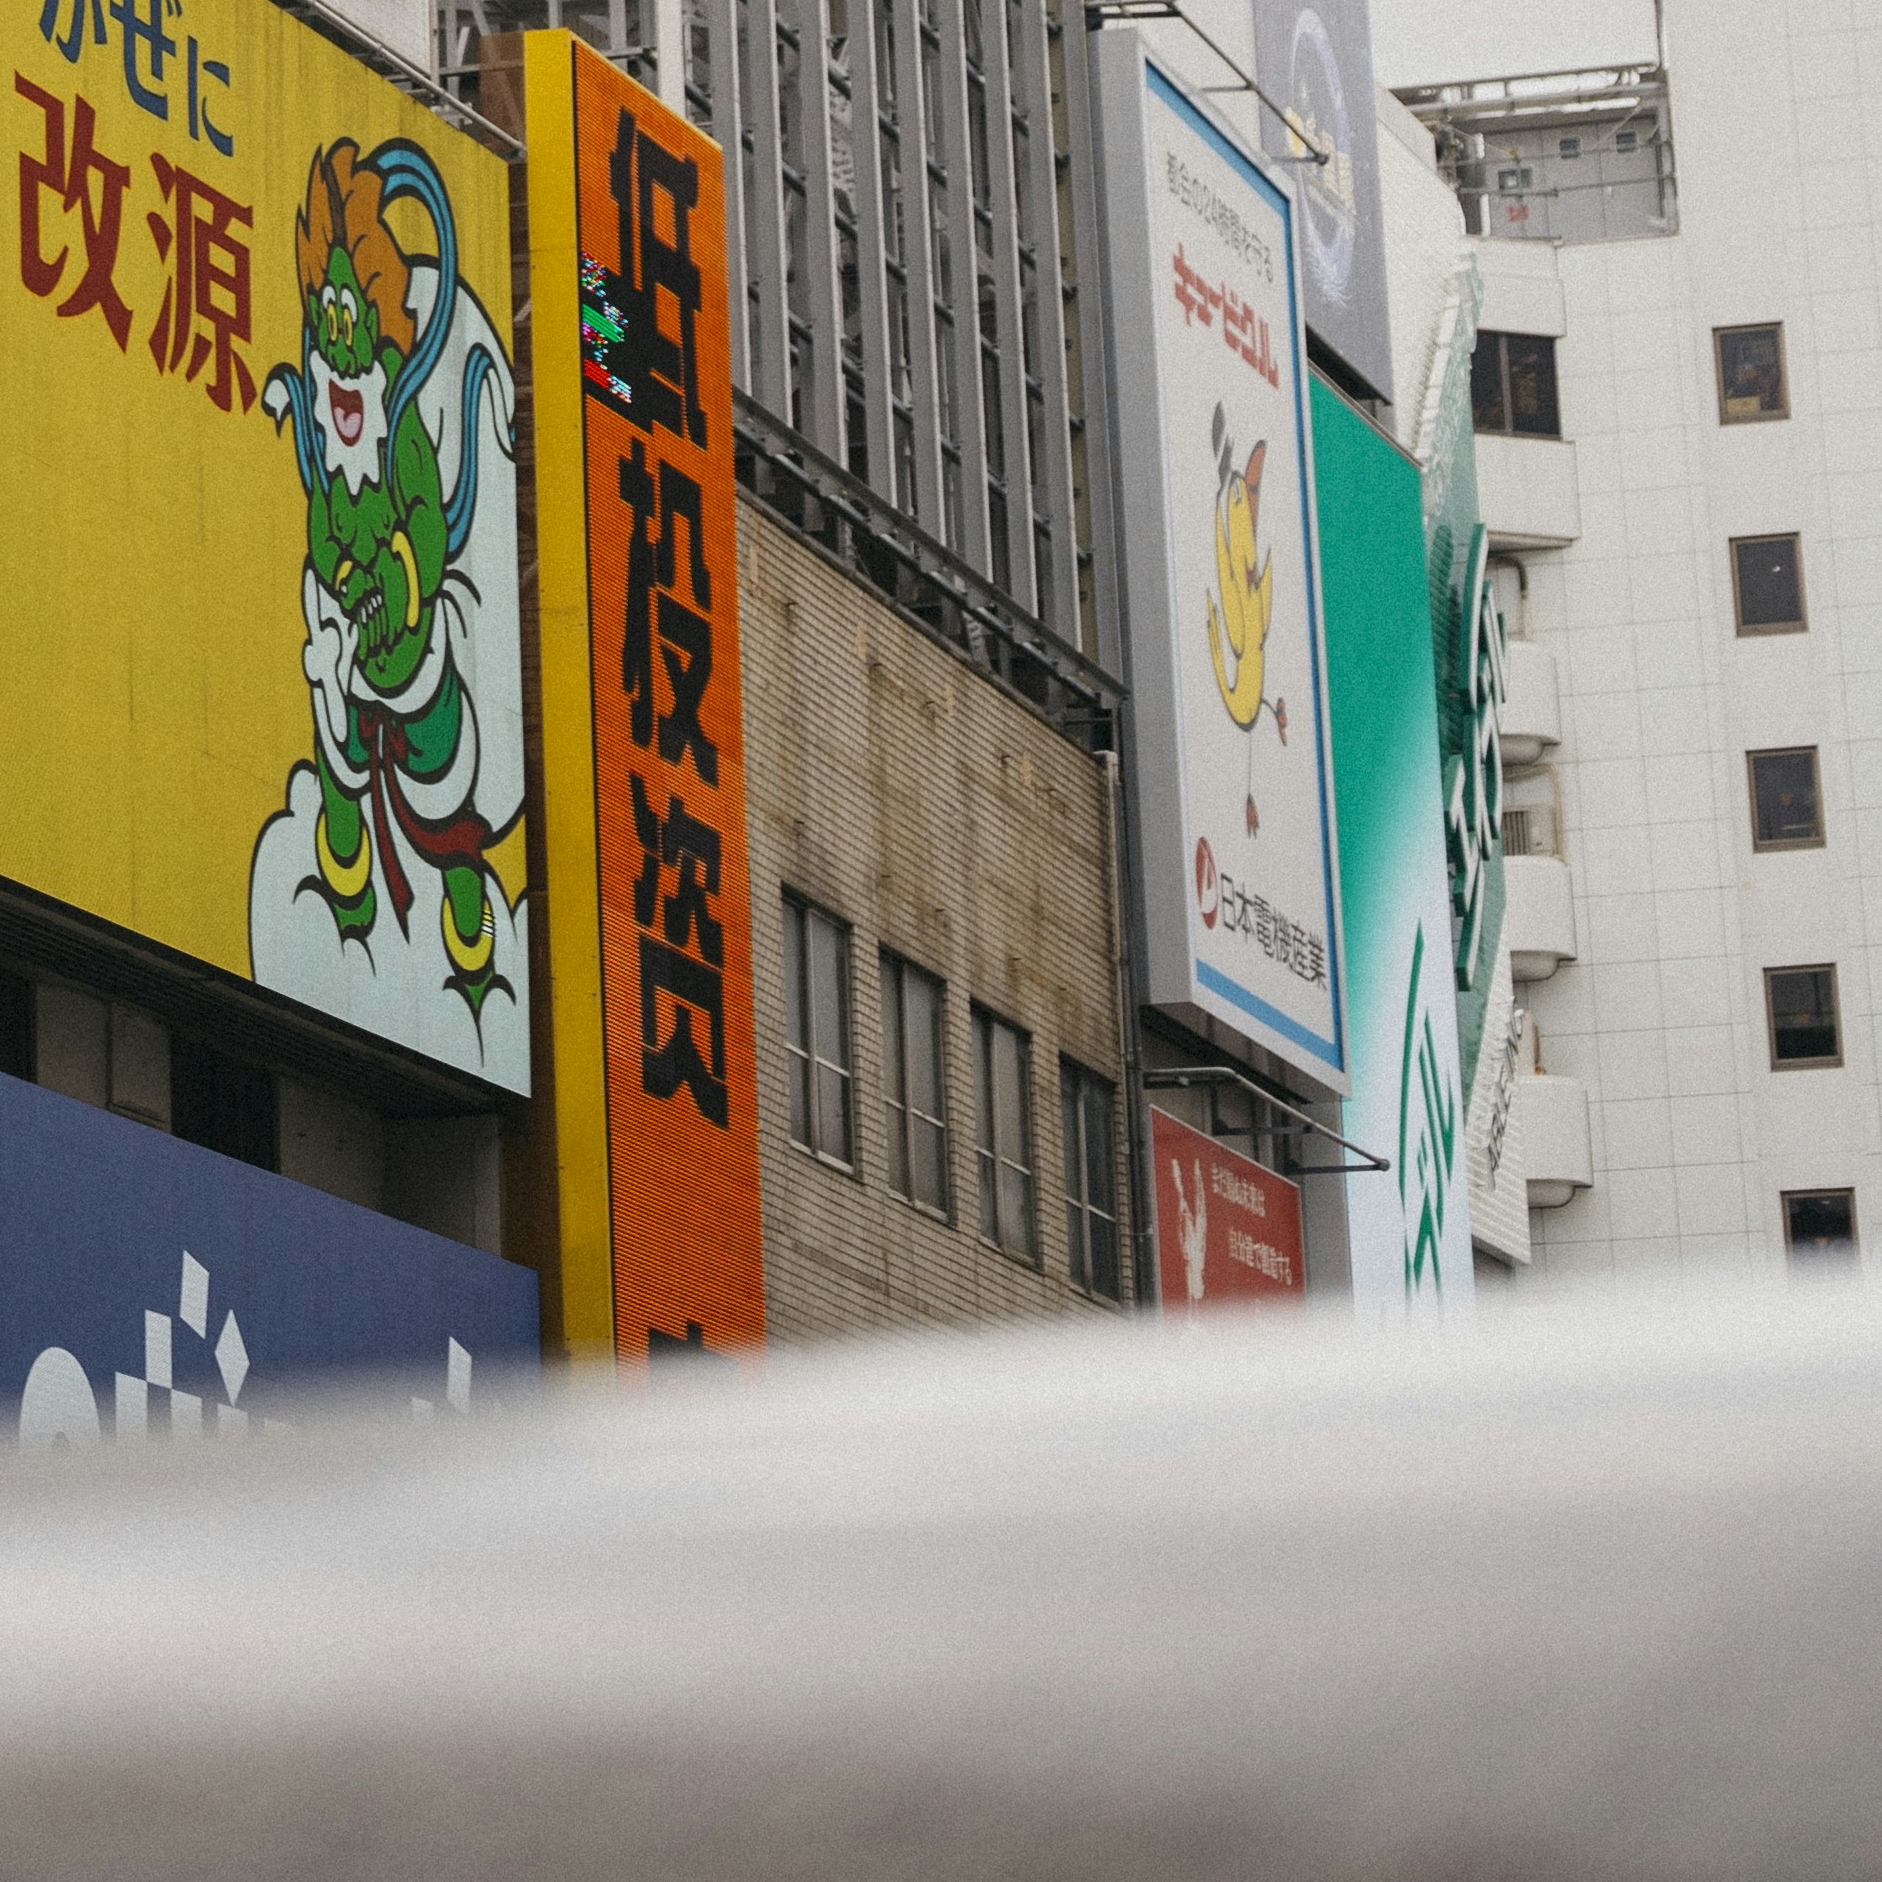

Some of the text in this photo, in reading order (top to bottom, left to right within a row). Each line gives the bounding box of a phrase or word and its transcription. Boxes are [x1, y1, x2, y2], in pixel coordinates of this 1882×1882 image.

[13, 70, 259, 418] 改源
[1172, 241, 1280, 390] キュービクル
[1220, 871, 1328, 991] 日本電機産業
